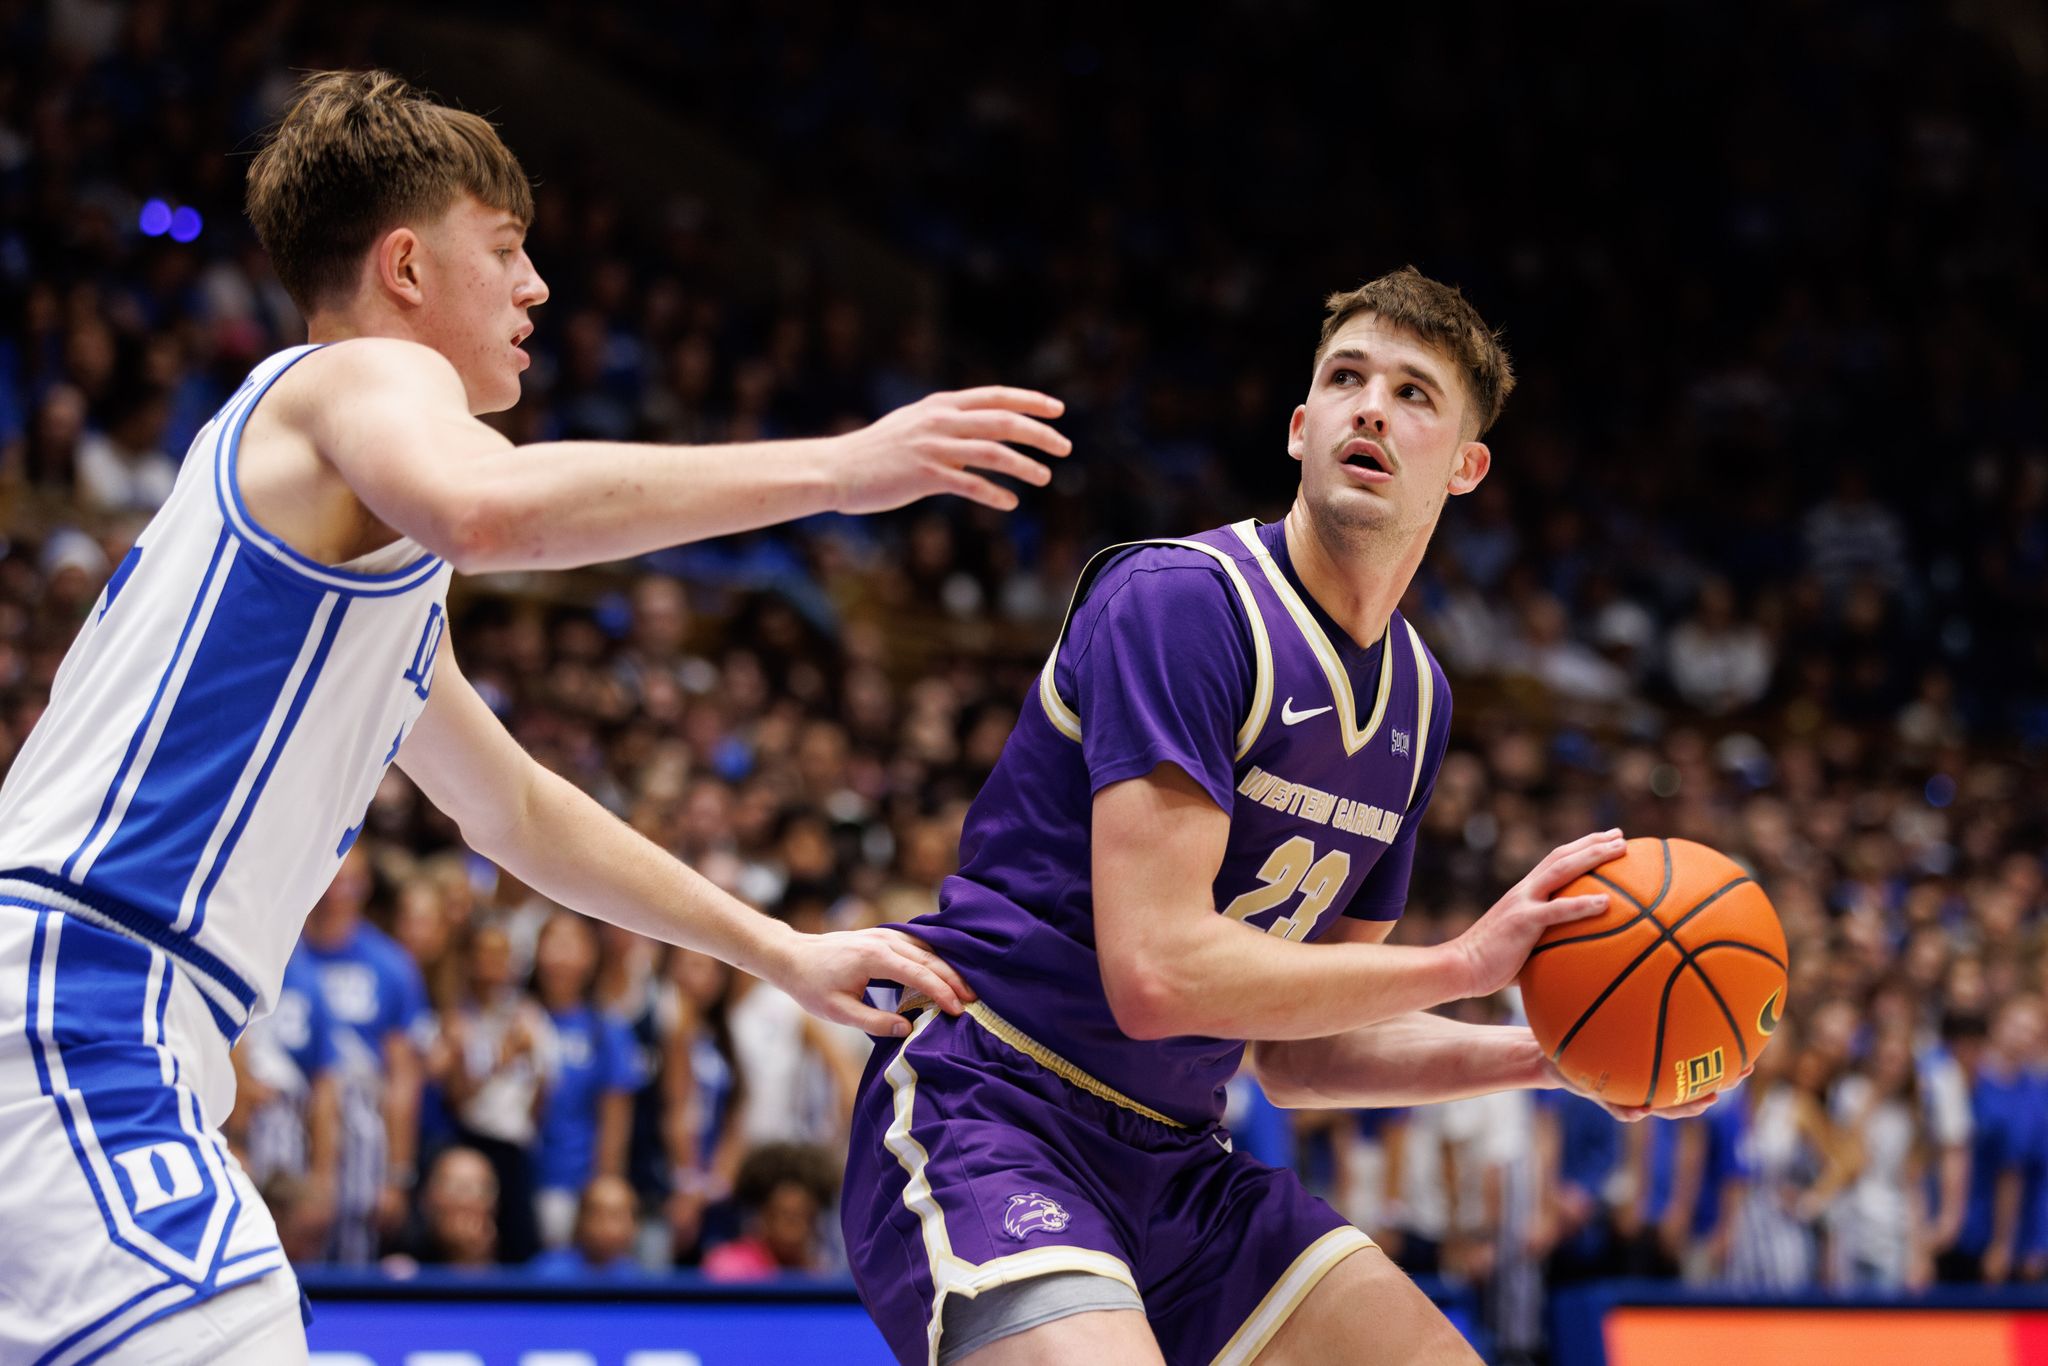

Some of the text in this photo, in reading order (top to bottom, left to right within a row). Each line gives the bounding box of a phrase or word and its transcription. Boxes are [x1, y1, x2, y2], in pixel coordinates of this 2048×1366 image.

[1236, 765, 1404, 845] WESTERN CAROLIN
[1221, 835, 1350, 942] 23
[113, 1141, 203, 1215] D
